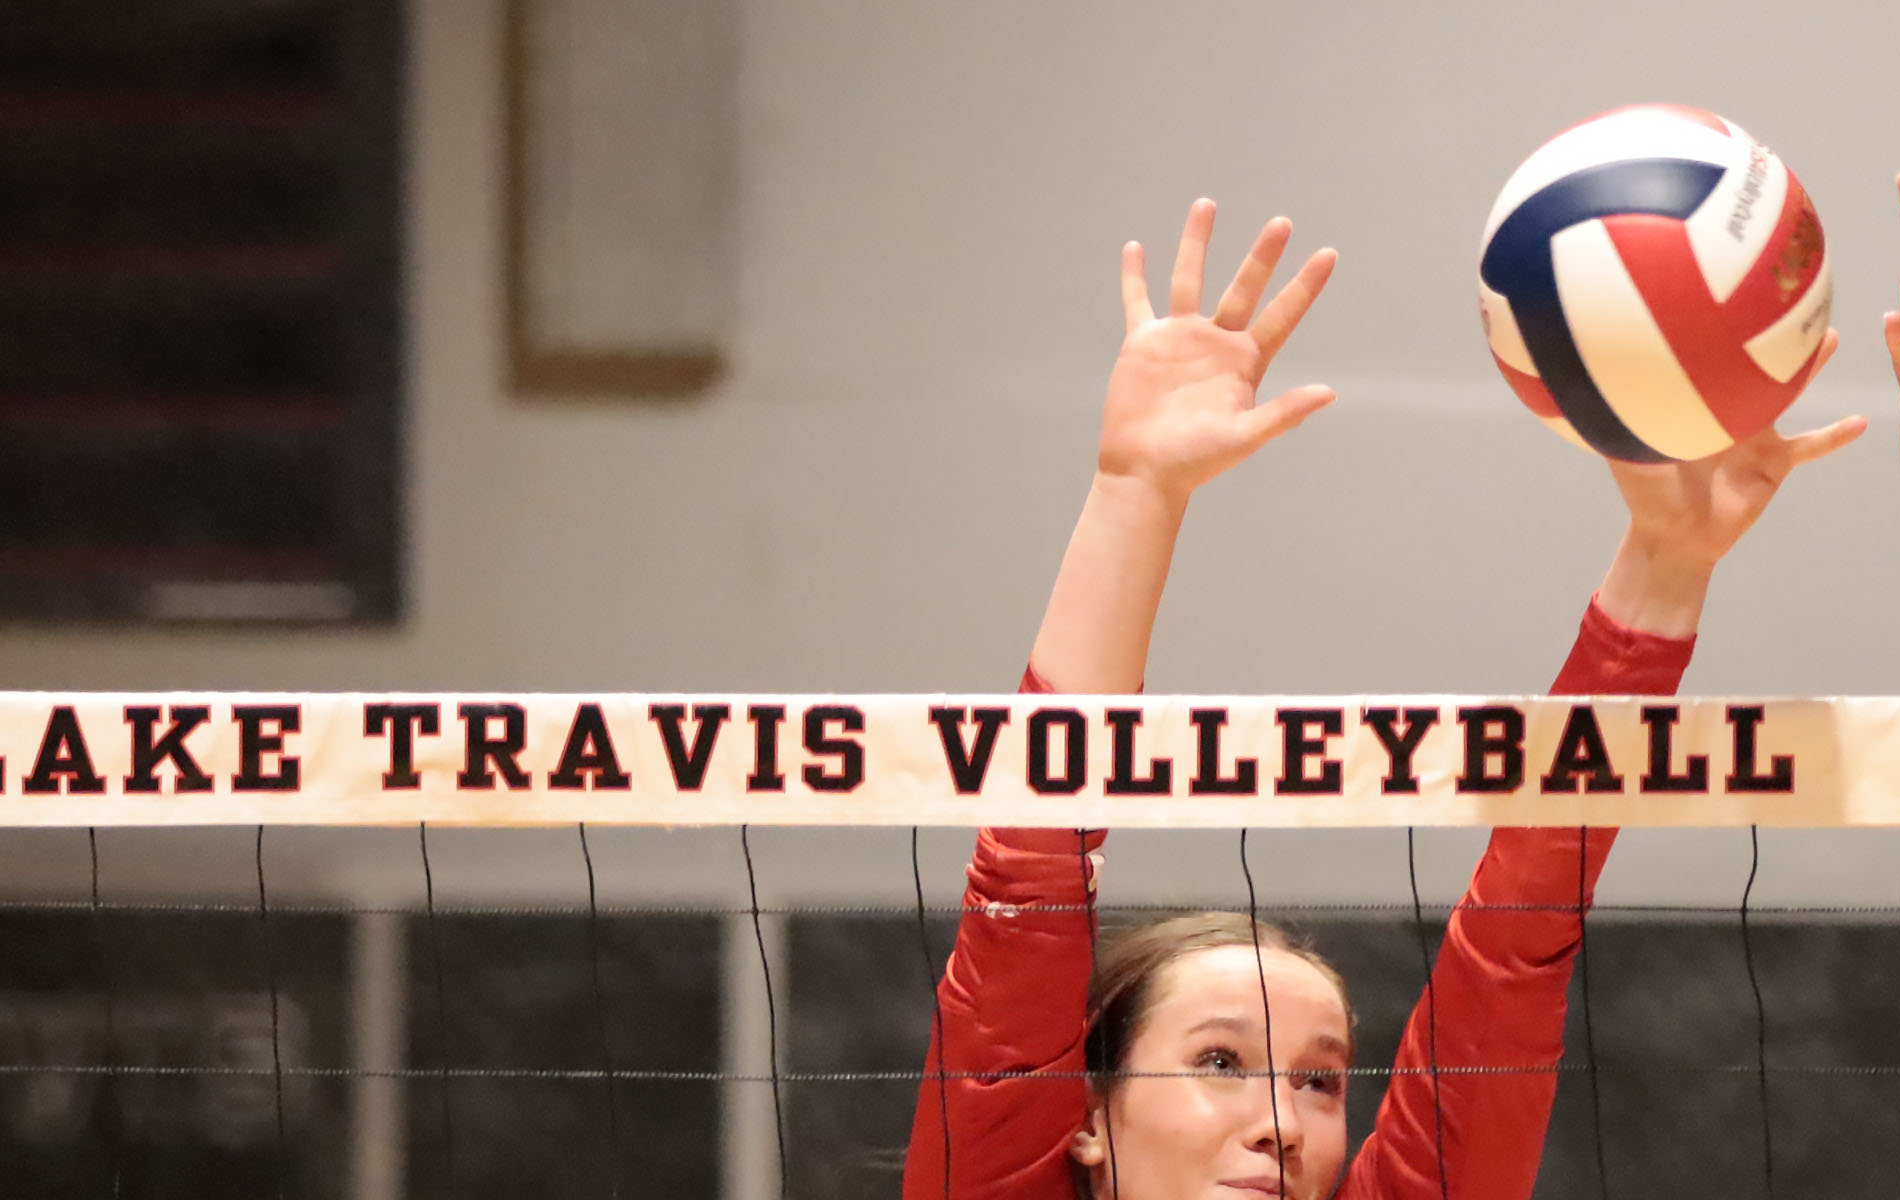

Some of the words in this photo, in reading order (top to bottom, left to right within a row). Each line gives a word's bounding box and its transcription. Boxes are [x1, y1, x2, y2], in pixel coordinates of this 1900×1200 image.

[0, 704, 302, 796] AKE
[363, 703, 866, 794] TRAVIS
[928, 704, 1796, 797] VOLLEYBALL
